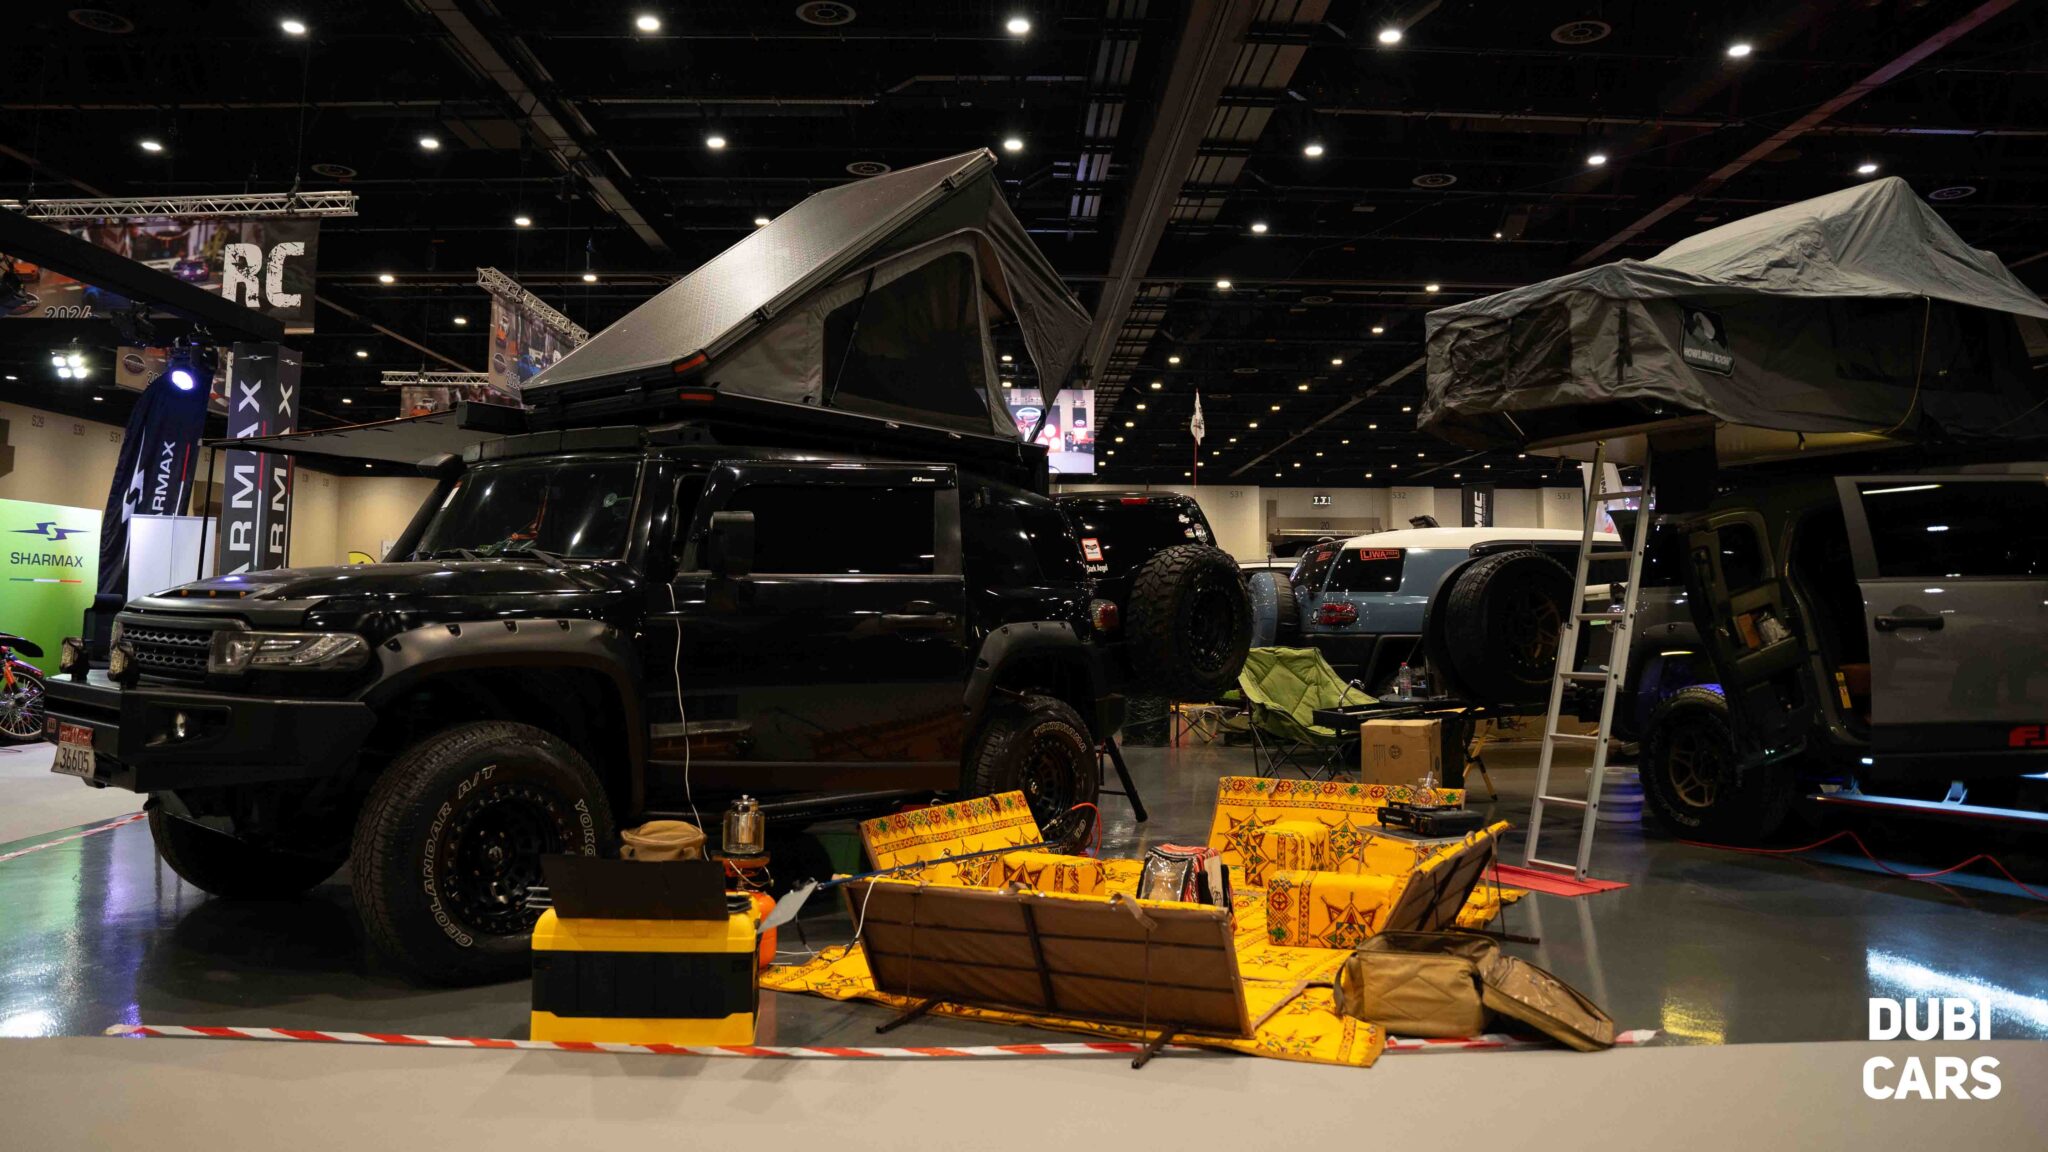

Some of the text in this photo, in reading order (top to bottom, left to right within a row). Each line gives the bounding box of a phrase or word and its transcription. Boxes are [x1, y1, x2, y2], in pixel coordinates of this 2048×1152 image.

[222, 241, 305, 308] RC
[10, 551, 83, 568] SHARMAX
[60, 747, 90, 773] 36605
[458, 764, 497, 800] A/T
[423, 801, 473, 948] GEOLANDAR
